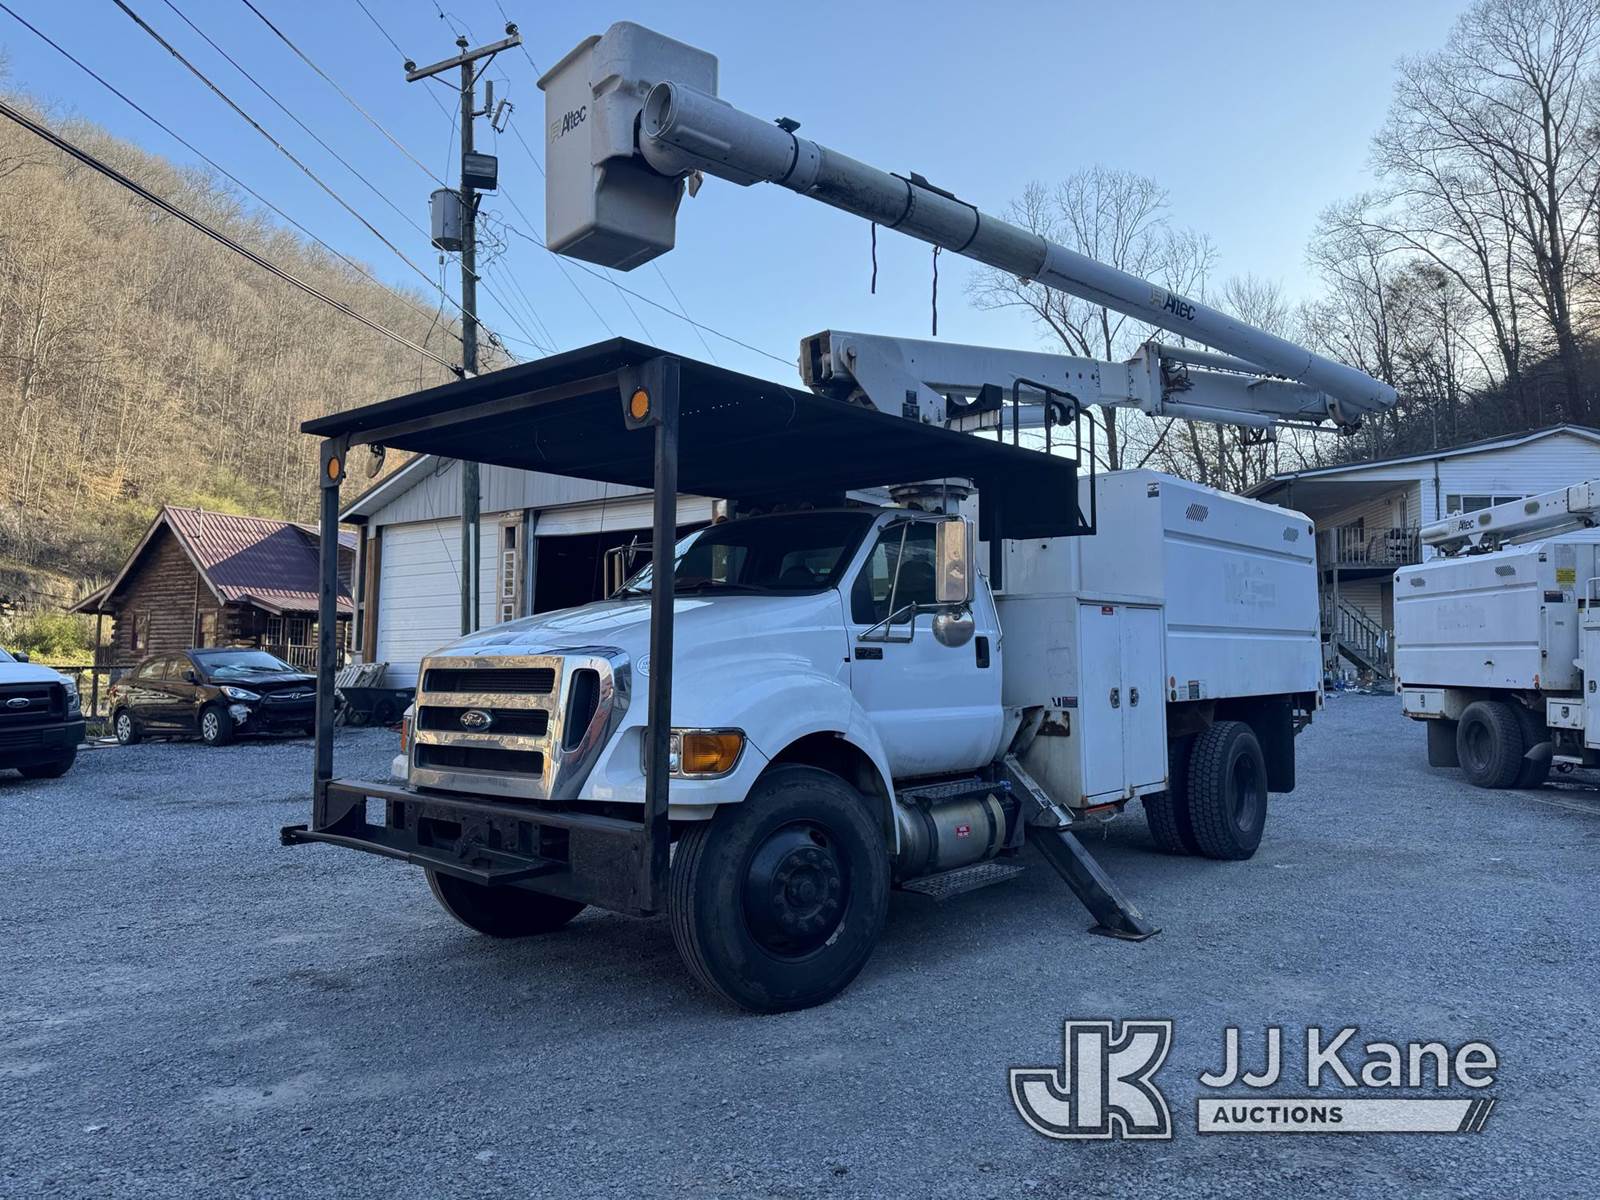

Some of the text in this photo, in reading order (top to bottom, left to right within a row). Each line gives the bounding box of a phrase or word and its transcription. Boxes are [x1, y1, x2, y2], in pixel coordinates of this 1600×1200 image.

[561, 105, 587, 136] Altec
[1163, 292, 1196, 321] Altec
[1458, 519, 1474, 531] Altec
